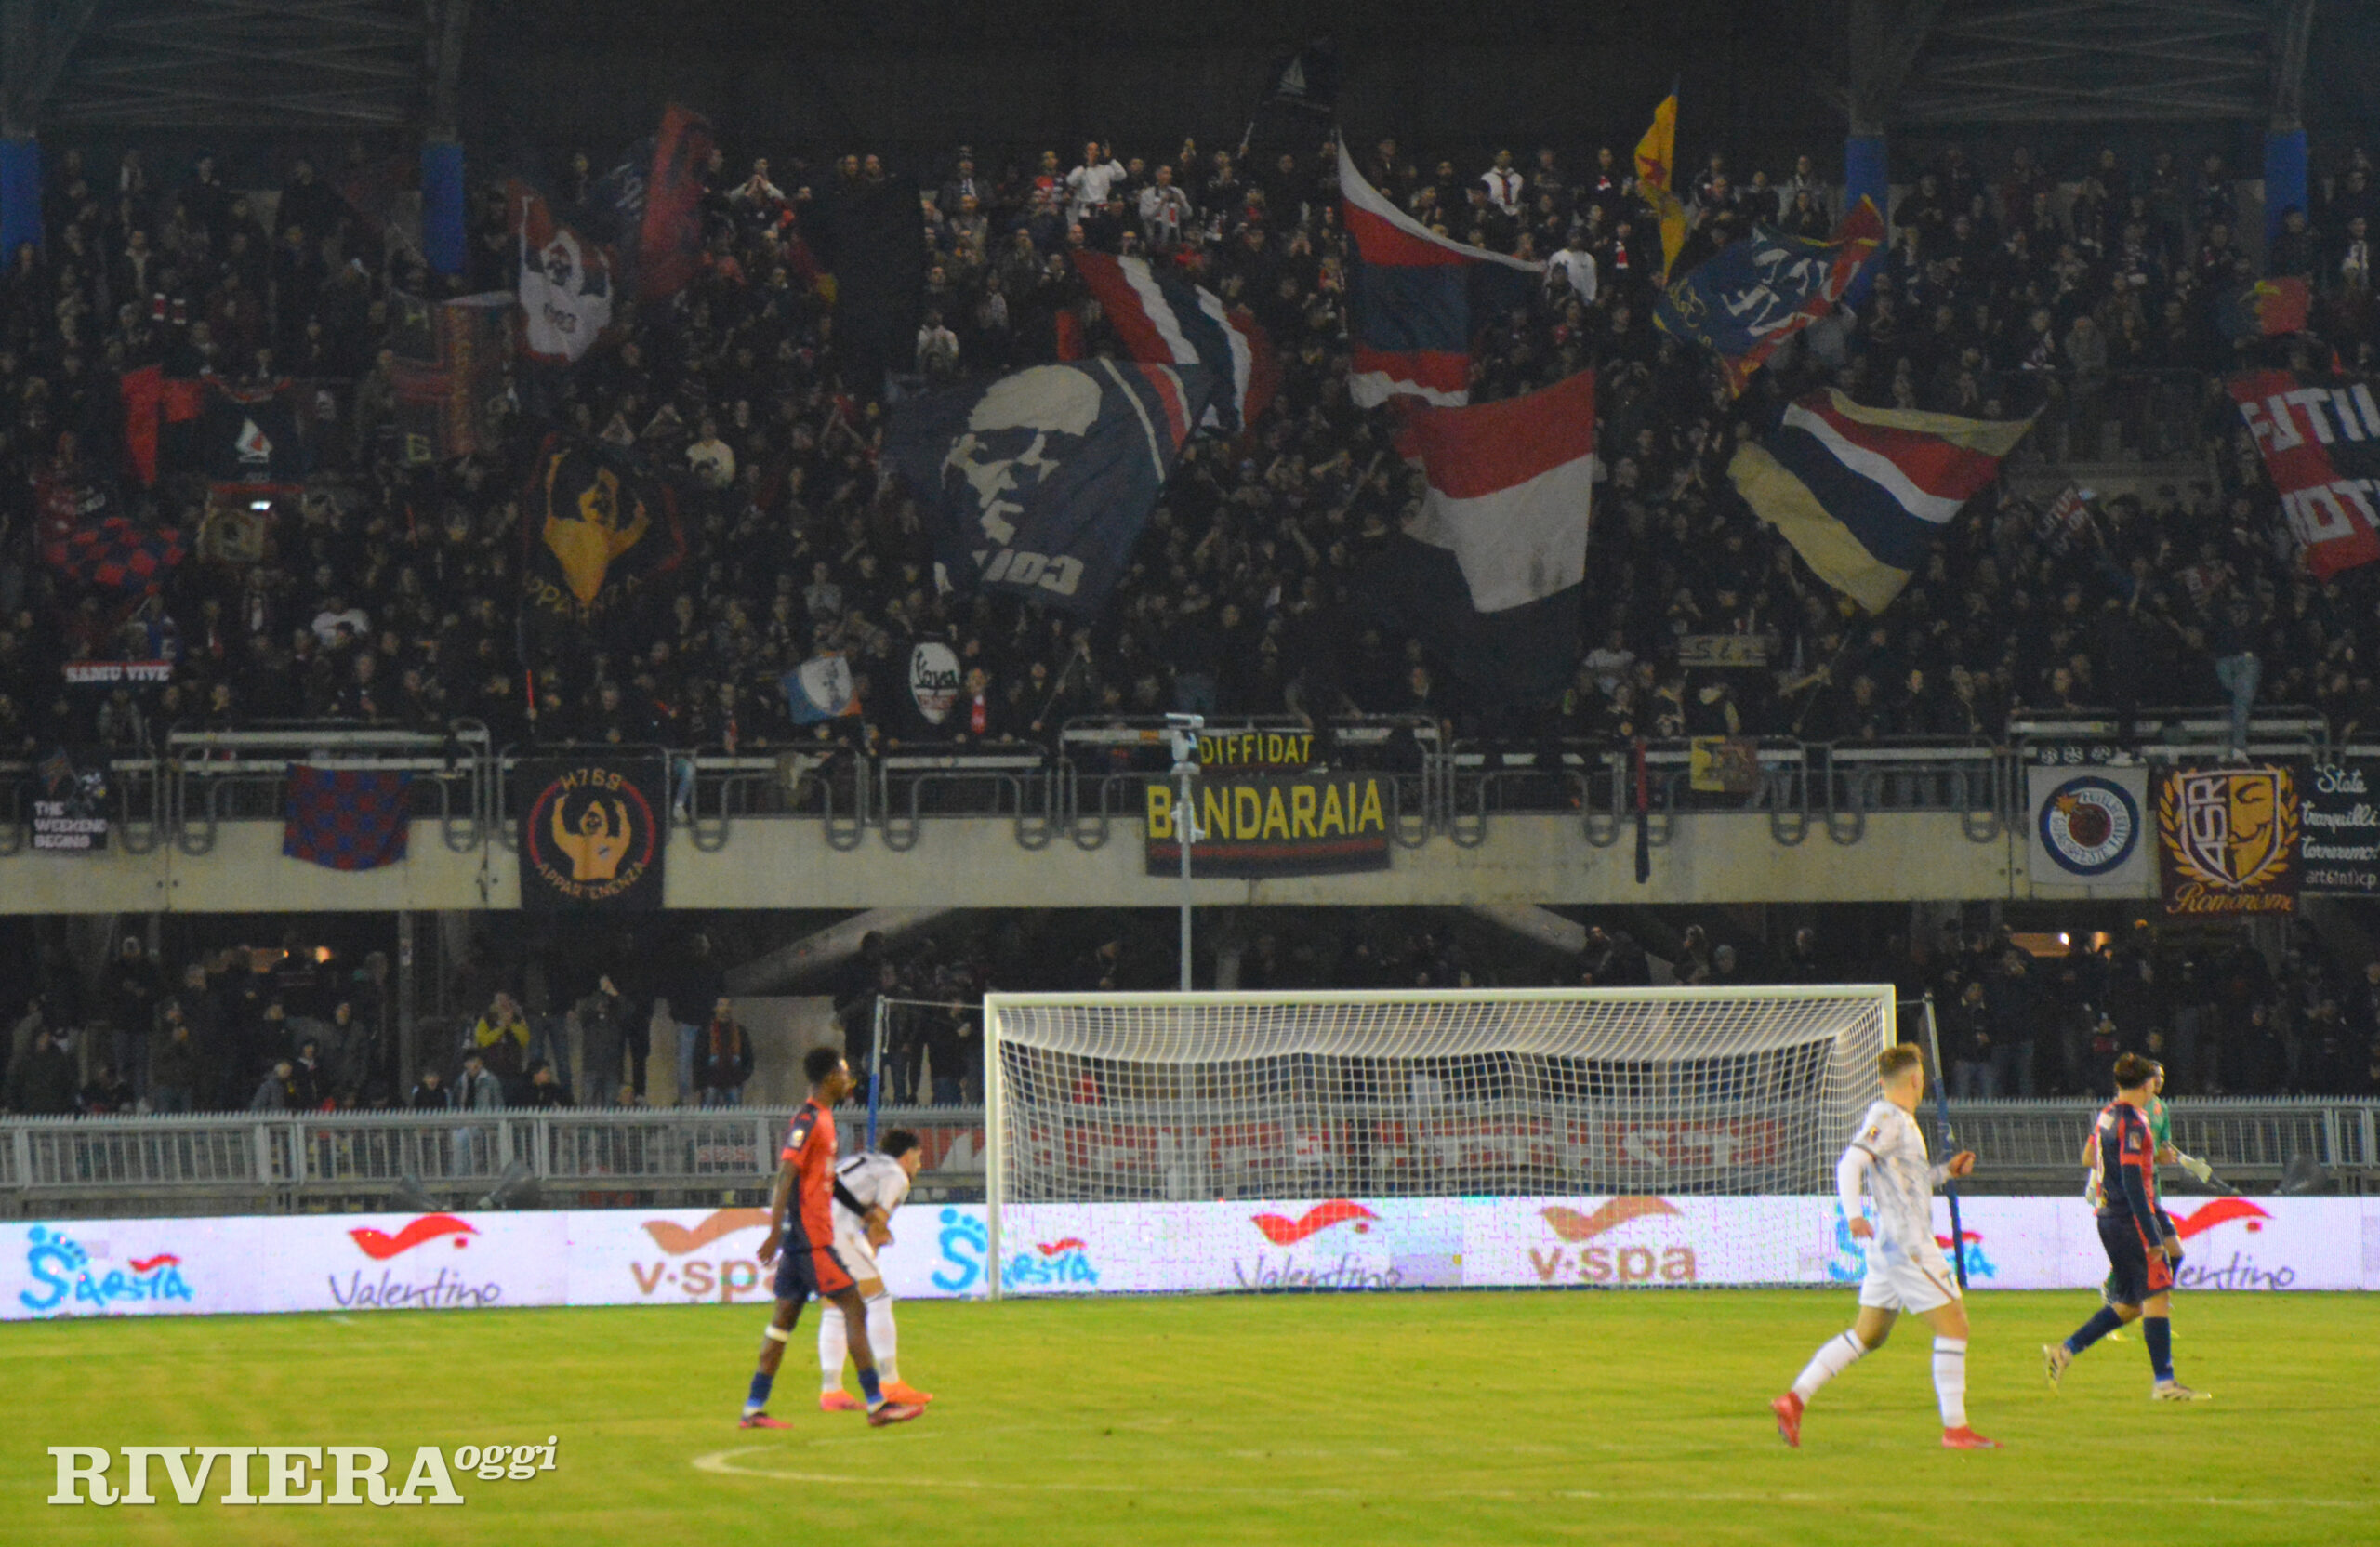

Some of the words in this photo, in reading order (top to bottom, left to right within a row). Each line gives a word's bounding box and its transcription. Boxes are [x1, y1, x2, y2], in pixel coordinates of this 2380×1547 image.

[1199, 734, 1314, 764] DIFFIDAT
[329, 1266, 501, 1308] Valentino
[2178, 1251, 2295, 1290] entino
